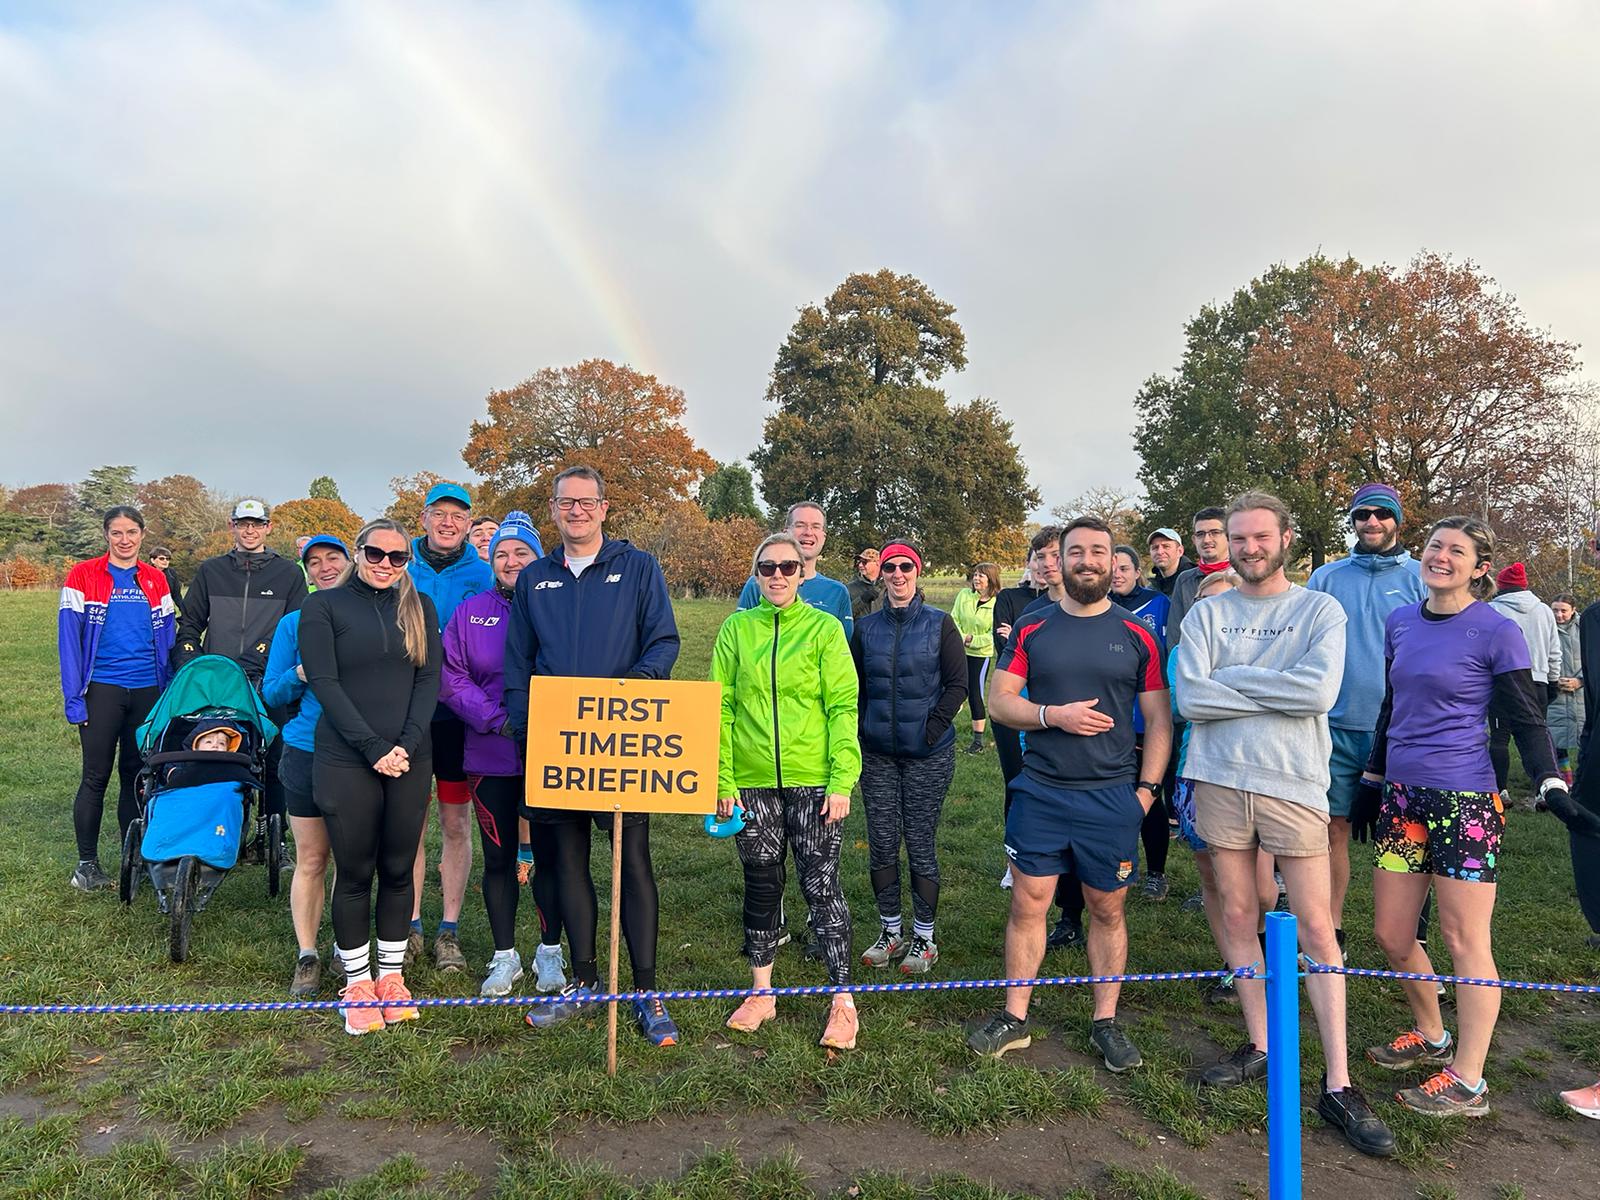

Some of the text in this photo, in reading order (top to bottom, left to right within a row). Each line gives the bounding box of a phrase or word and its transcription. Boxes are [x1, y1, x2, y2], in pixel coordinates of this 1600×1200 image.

[470, 615, 485, 625] tcs
[1109, 643, 1124, 653] HR
[577, 696, 670, 722] FIRST
[560, 731, 683, 758] TIMERS
[543, 765, 698, 794] BRIEFING
